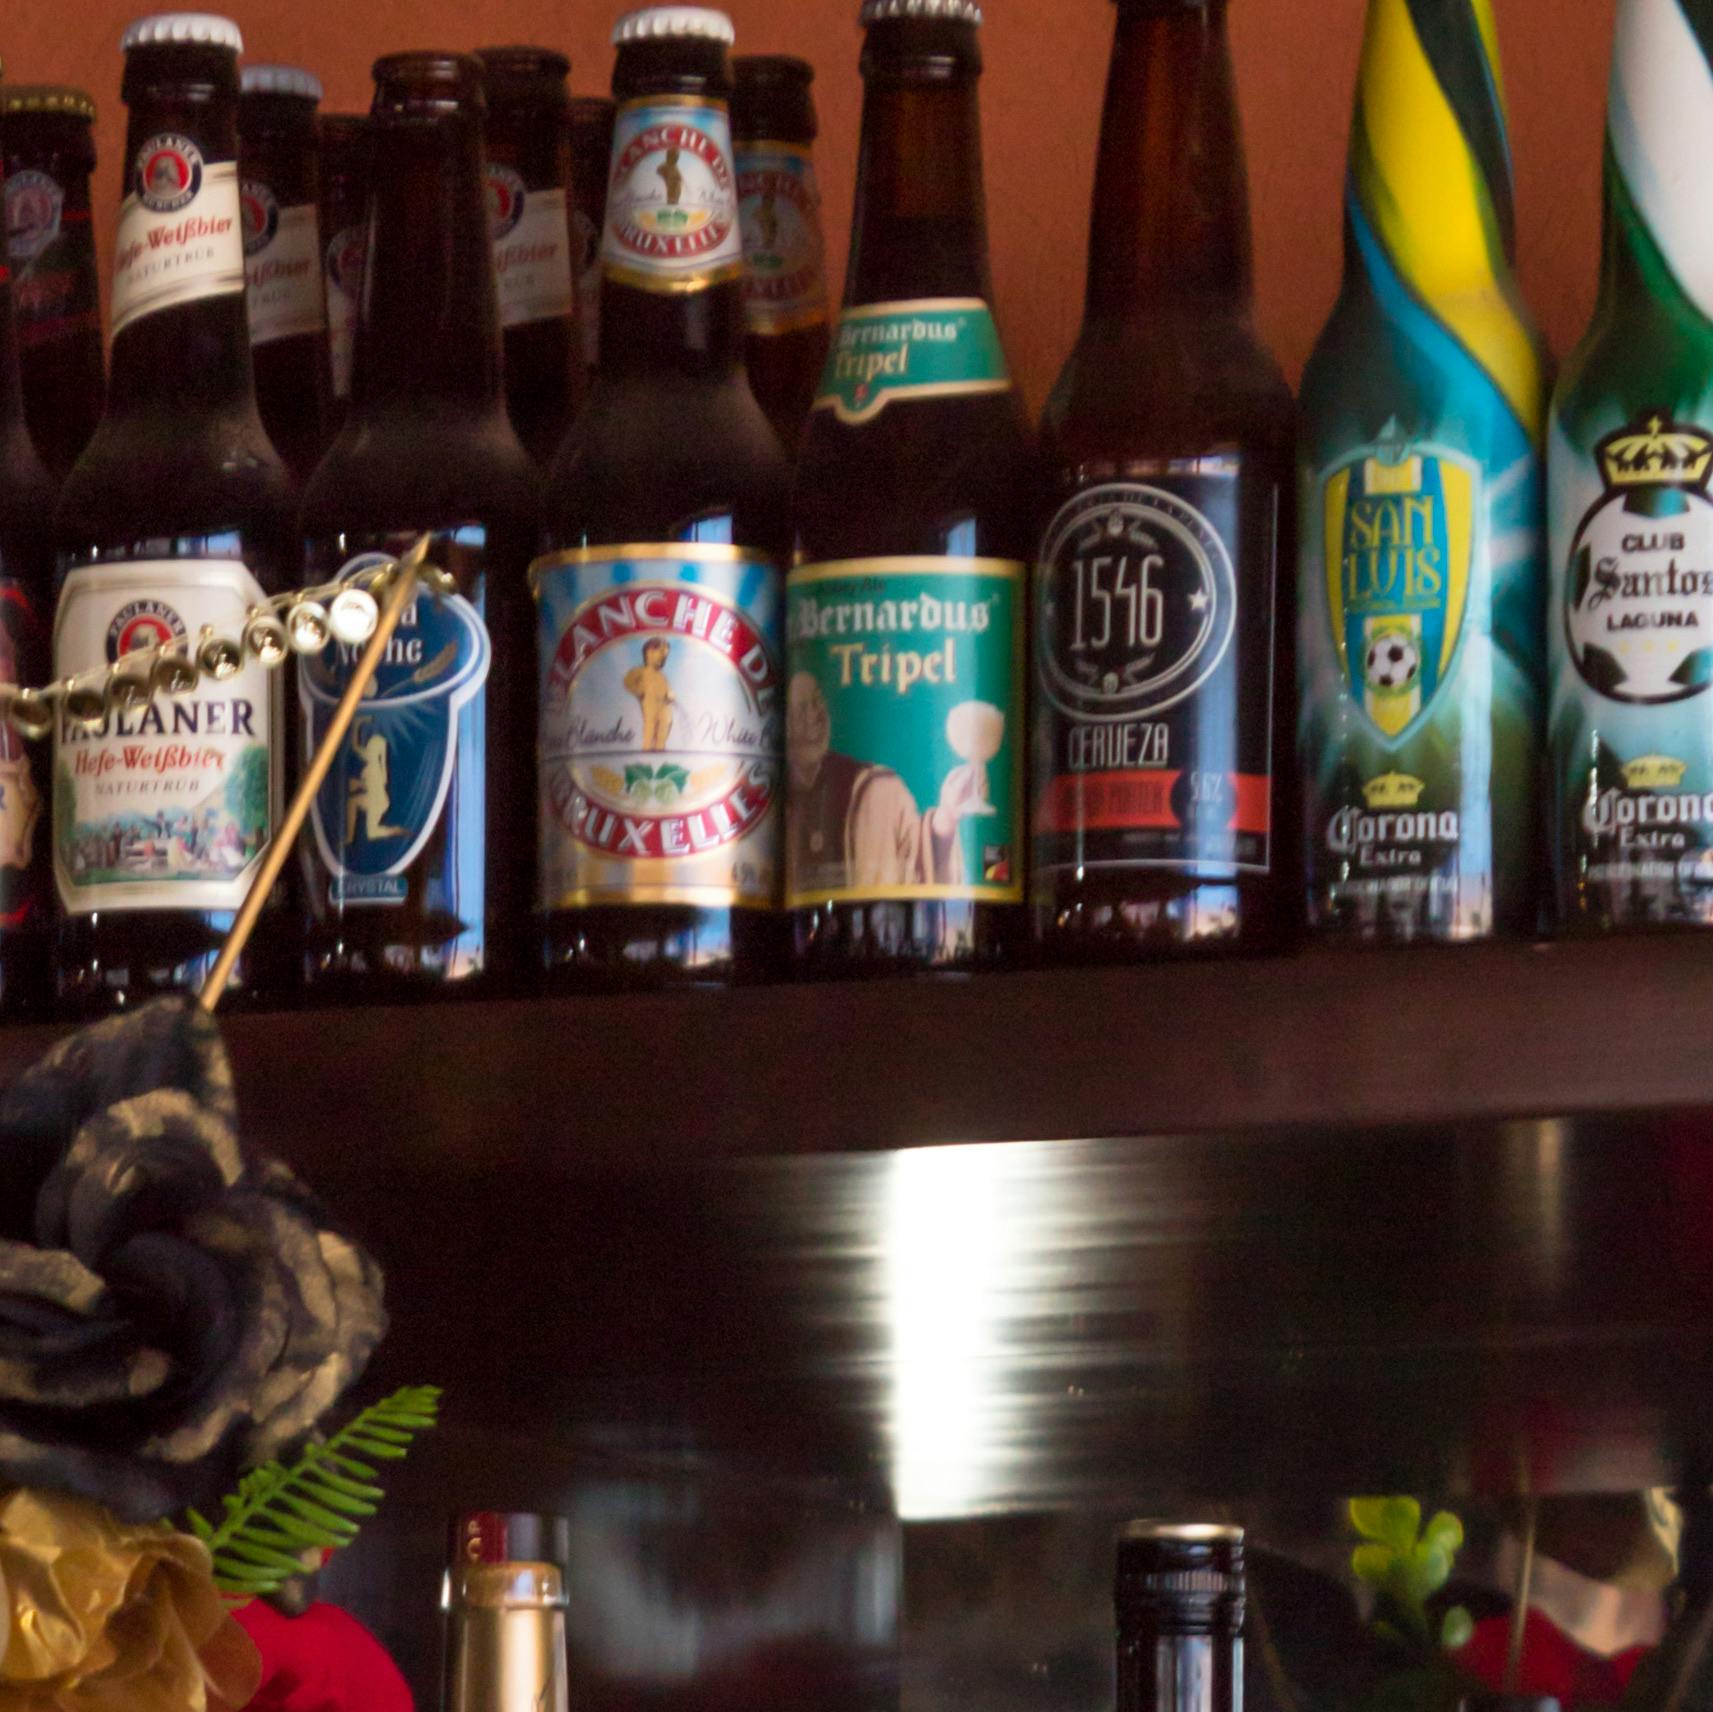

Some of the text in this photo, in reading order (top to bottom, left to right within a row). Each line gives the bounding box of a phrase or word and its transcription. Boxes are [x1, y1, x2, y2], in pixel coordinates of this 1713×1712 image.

[1349, 495, 1435, 549] SAN
[1621, 533, 1685, 552] CLUB
[1347, 545, 1444, 601] LUIS
[798, 592, 990, 640] Bernardus
[1069, 553, 1167, 652] 1546
[1606, 610, 1699, 633] LAGUNA
[546, 589, 739, 690] LANCHE
[831, 636, 957, 695] Tripel
[60, 698, 255, 745] ULANER
[1068, 721, 1170, 769] CERVEZA
[75, 744, 227, 778] Hefe-Weißbier
[1327, 804, 1459, 855] Corona
[1359, 845, 1422, 867] Extra
